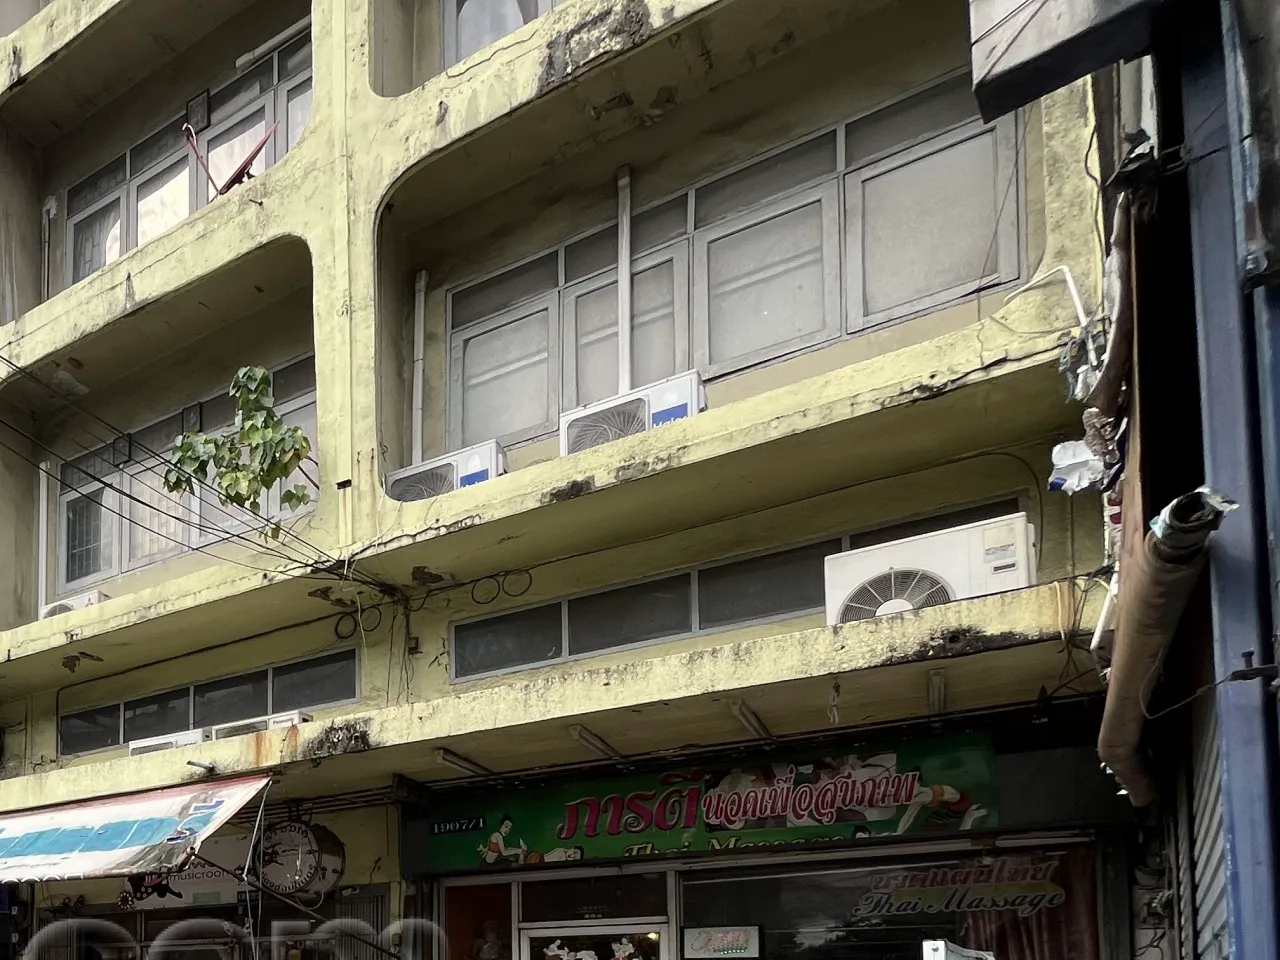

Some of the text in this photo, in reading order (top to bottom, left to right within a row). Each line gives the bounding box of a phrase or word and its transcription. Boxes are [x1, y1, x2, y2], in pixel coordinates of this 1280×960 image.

[433, 817, 484, 835] 1907/1
[853, 886, 1066, 917] Thai Massage
